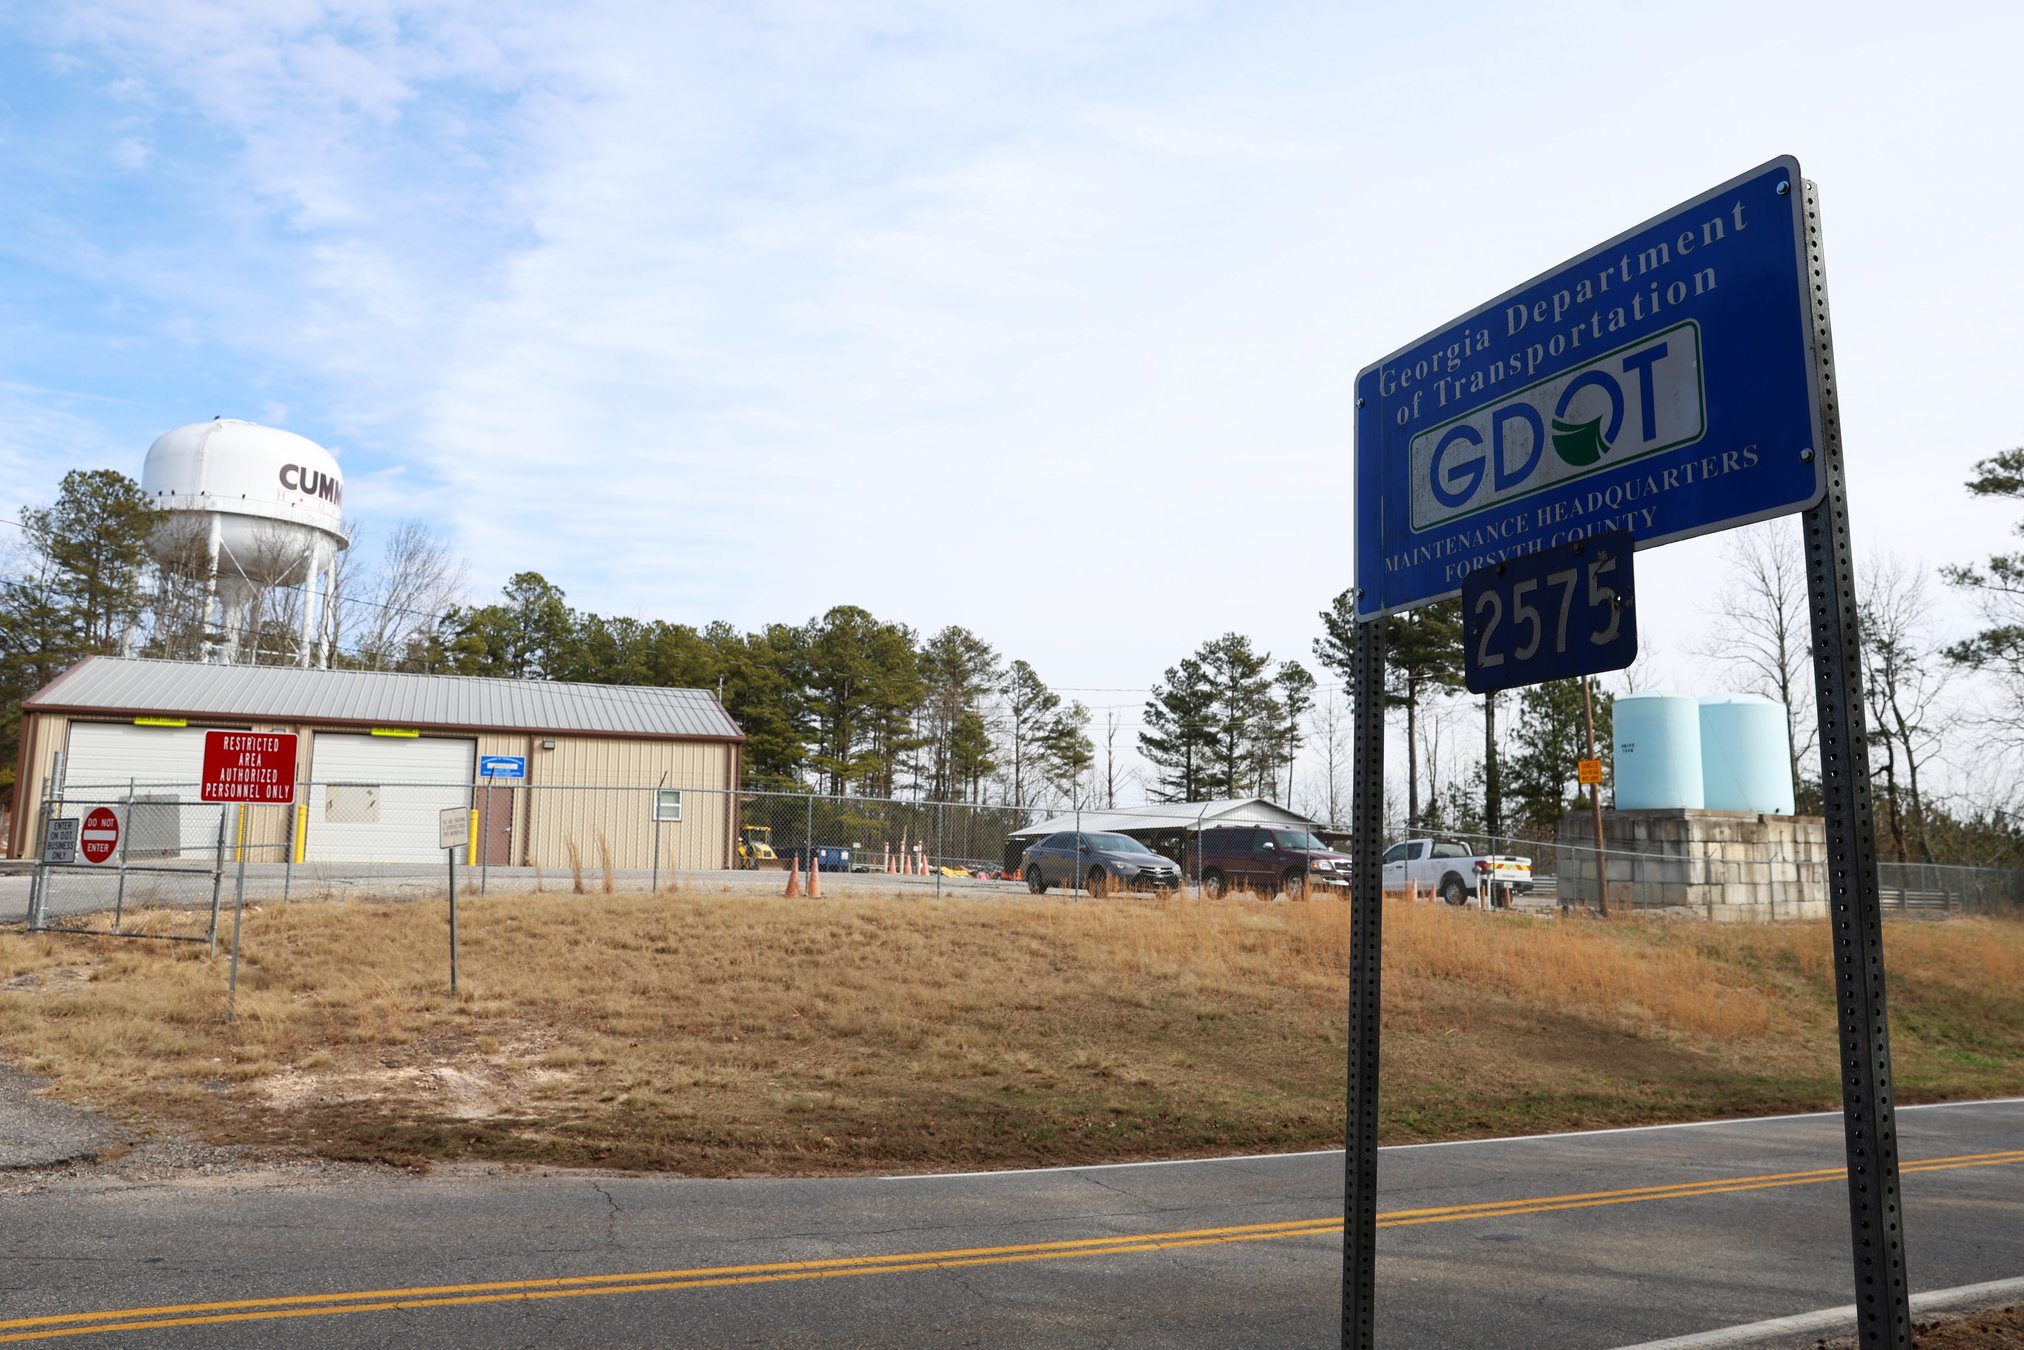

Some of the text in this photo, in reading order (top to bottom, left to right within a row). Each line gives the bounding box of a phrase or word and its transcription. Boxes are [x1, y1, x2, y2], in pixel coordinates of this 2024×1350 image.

[1379, 200, 1748, 397] Georgia Department
[1396, 266, 1718, 425] of Transportation
[1430, 341, 1668, 508] GDOT
[1384, 443, 1760, 575] MAINTENANCE HEADQUARTERS
[1551, 506, 1657, 548] COUNTY
[1475, 558, 1621, 668] 2575
[223, 736, 279, 752] RESTRICTED
[238, 752, 262, 767] AREA
[219, 767, 278, 783] AUTHORIZED
[205, 782, 290, 799] PERSONNEL ONLY
[53, 821, 73, 831] ENTER
[87, 818, 115, 828] DO NOT
[50, 831, 59, 840] ON
[47, 841, 74, 851] BUSINESS
[87, 843, 110, 853] ENTER
[52, 851, 67, 860] ONLY
